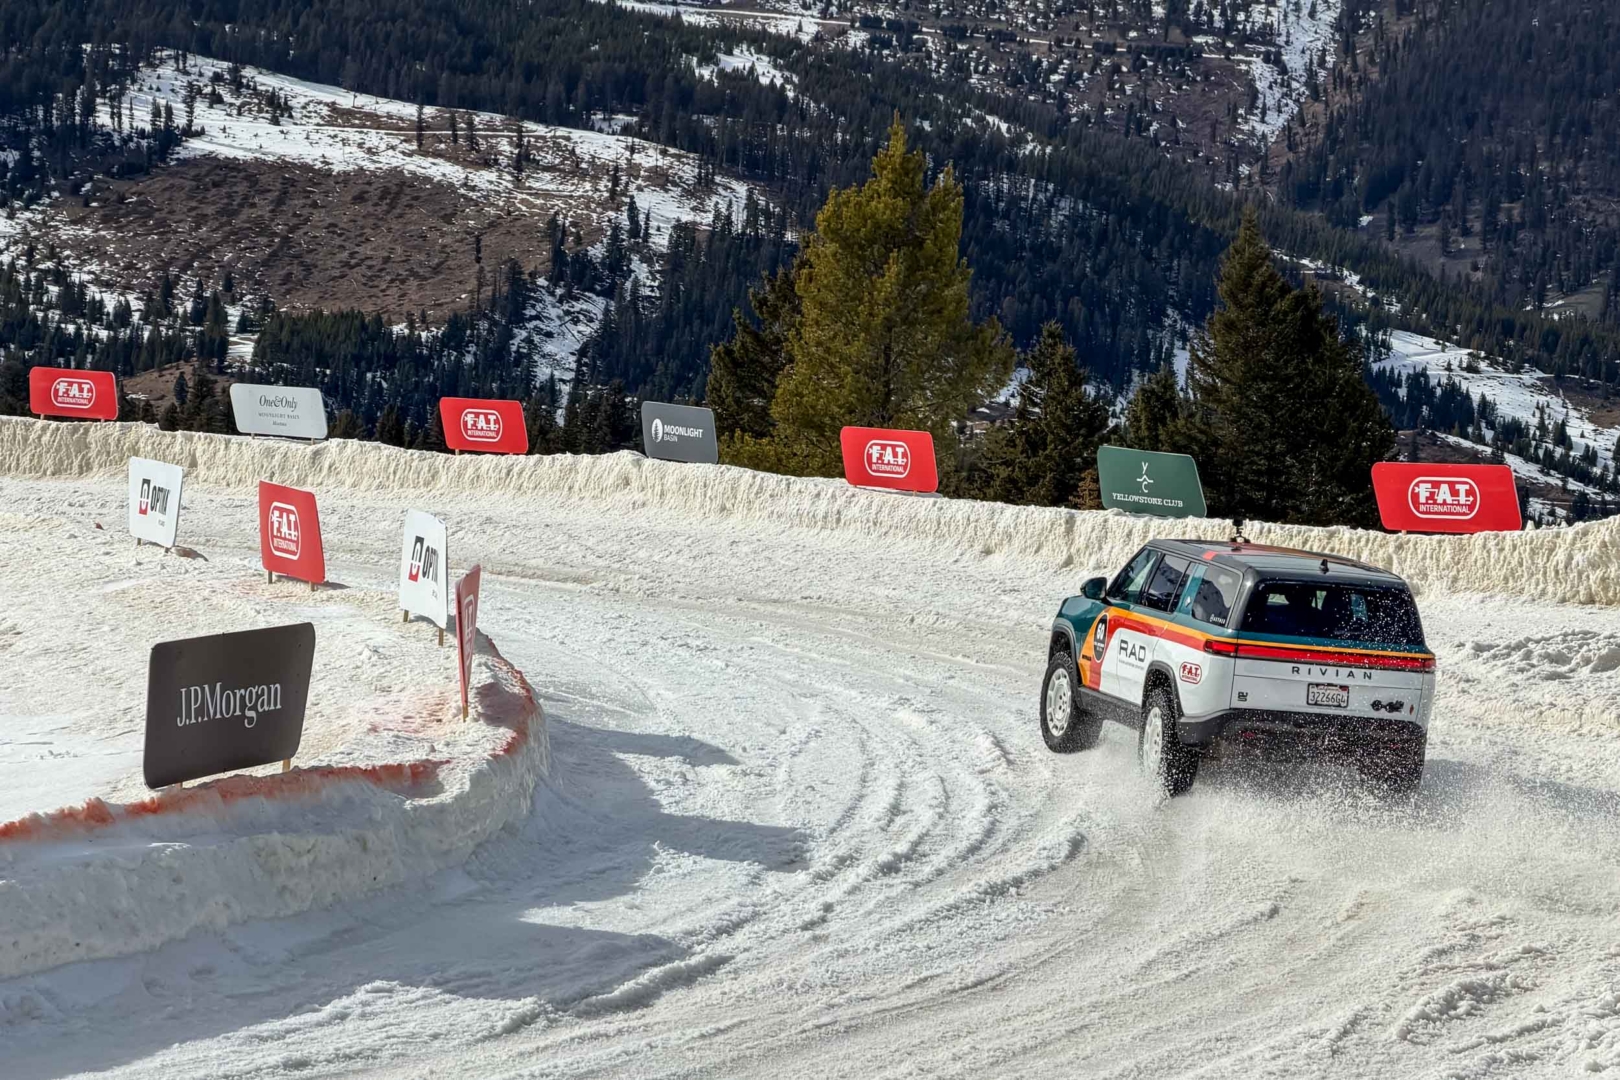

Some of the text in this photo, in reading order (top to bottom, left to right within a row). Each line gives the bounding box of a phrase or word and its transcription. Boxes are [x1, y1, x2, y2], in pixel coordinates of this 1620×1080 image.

[57, 396, 89, 405] INTERNATIONAL
[259, 394, 298, 412] One&Only
[467, 429, 498, 438] INTERNATIONAL
[663, 424, 704, 439] MOONLIGHT
[663, 433, 678, 443] BASIN
[871, 463, 905, 474] INTERNATIONAL
[1112, 492, 1184, 508] YELLOWSTONE CLUB
[1418, 483, 1472, 505] F.A.T.
[1419, 504, 1471, 514] INTERNATIONAL
[273, 537, 298, 553] INTERNATIONAL
[1118, 638, 1146, 663] RAD
[1291, 666, 1372, 681] RIVIAN
[1309, 690, 1346, 706] 32266G4
